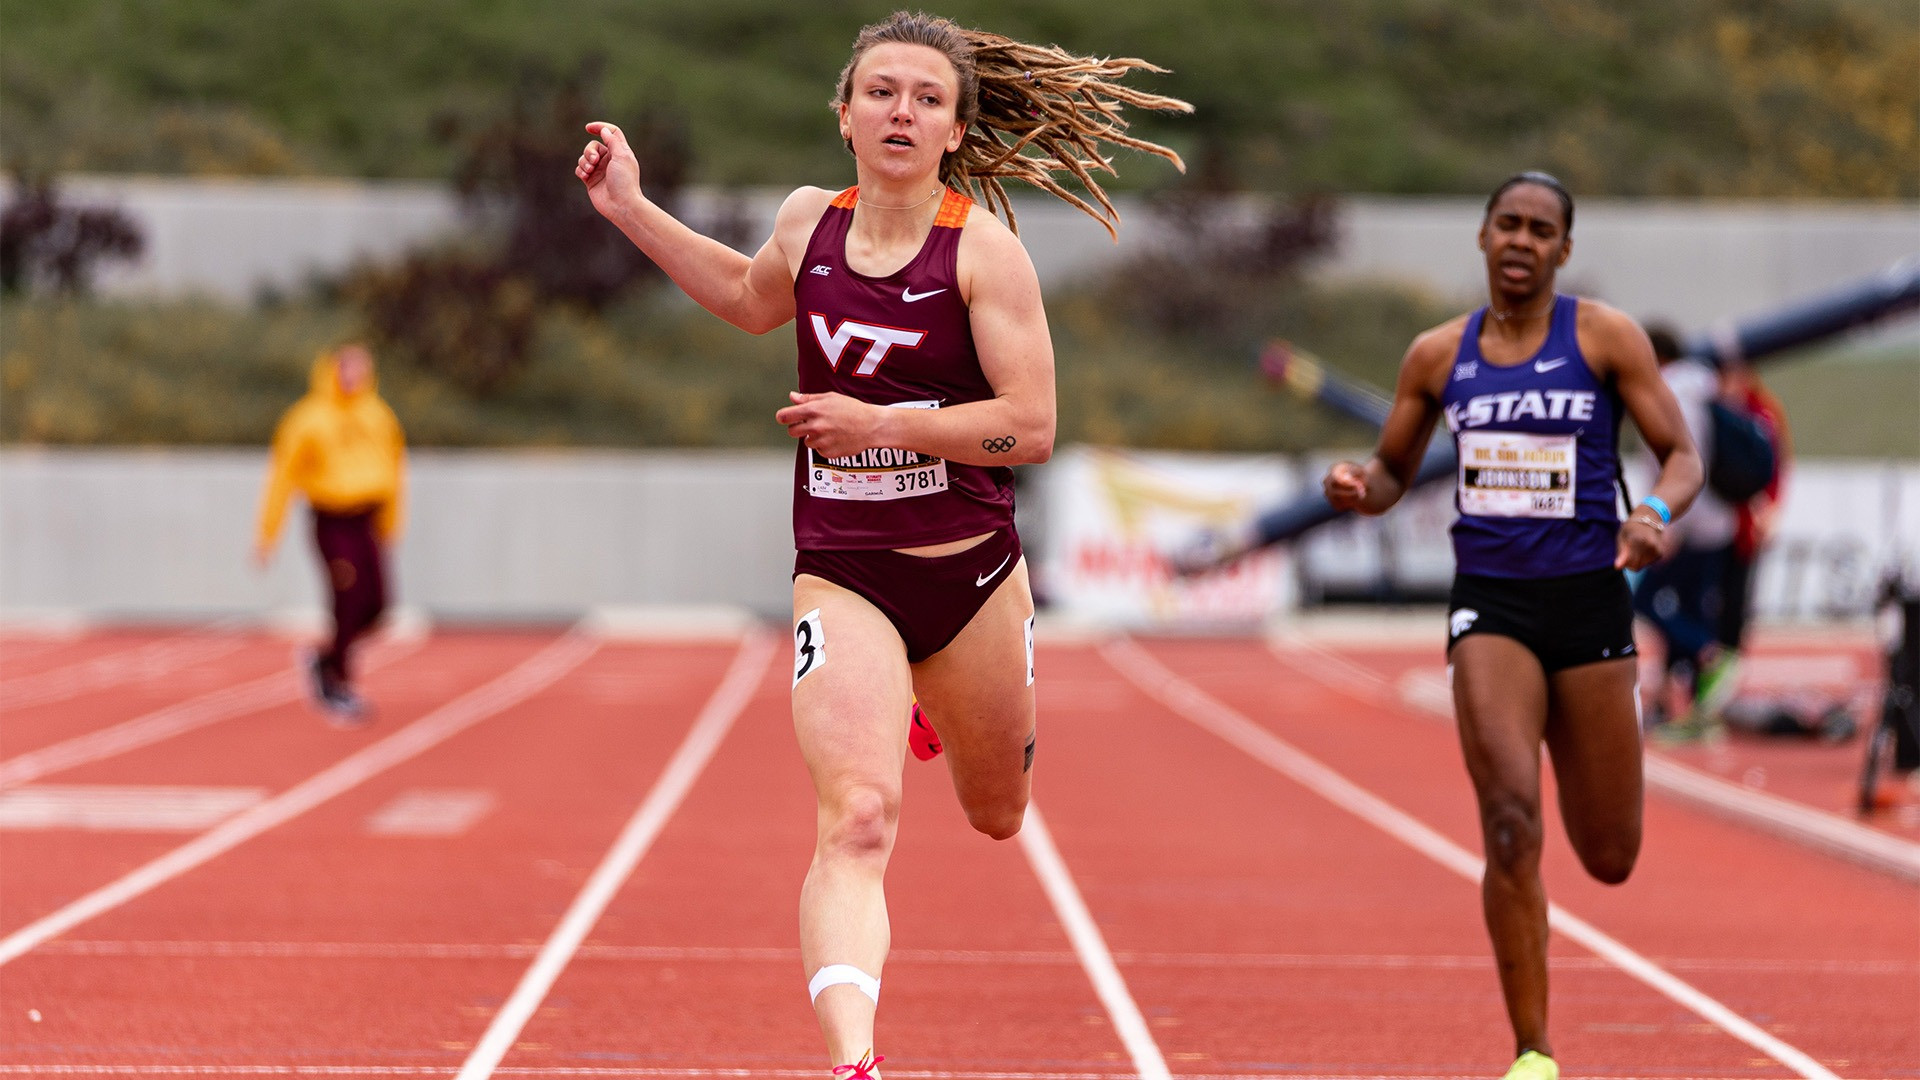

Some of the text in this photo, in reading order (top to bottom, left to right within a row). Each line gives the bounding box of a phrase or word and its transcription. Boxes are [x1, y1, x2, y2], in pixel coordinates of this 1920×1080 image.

[810, 264, 832, 276] ACC
[808, 311, 929, 378] VT
[1444, 389, 1596, 432] K-STATE
[895, 469, 937, 492] 3781
[1476, 469, 1551, 488] JOHNSON
[1532, 497, 1565, 511] 1687
[797, 620, 816, 680] 3
